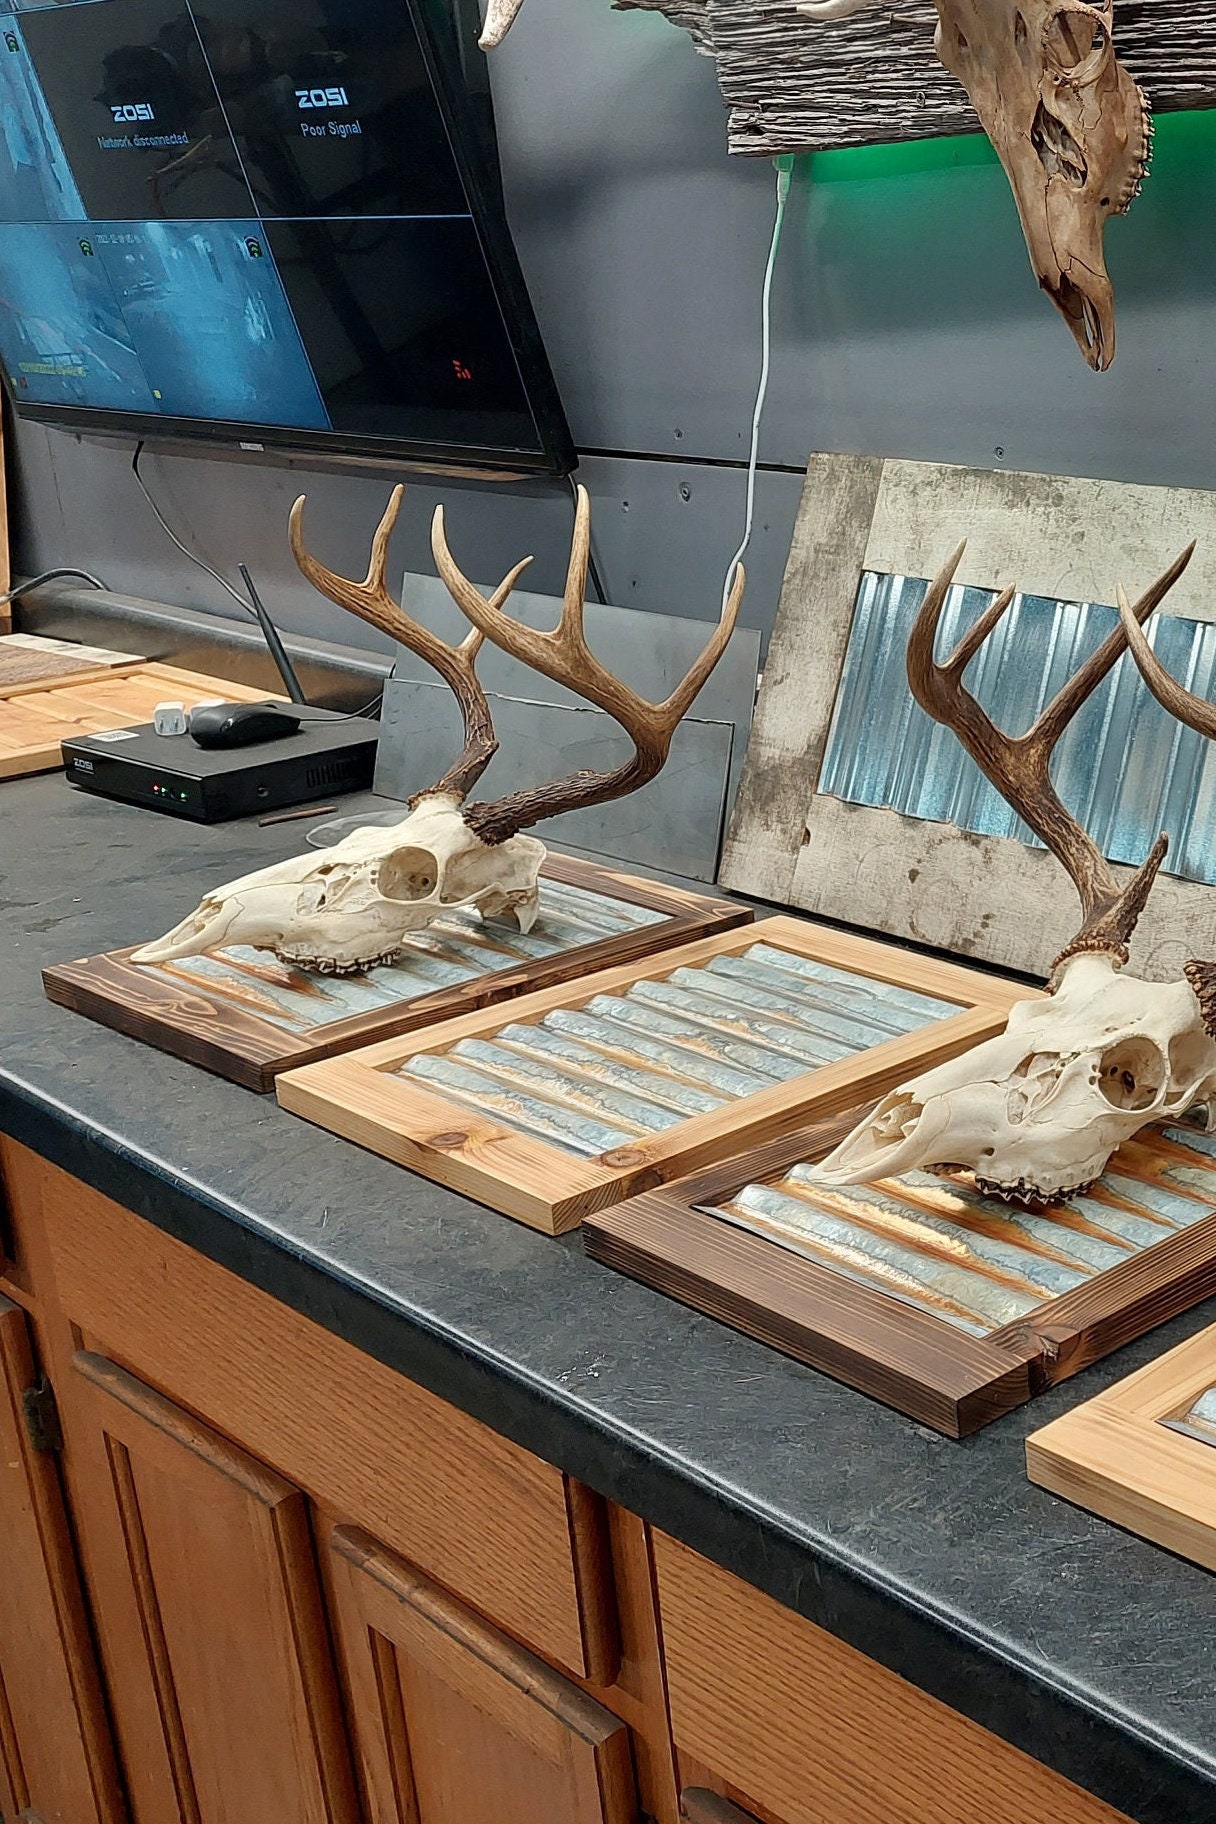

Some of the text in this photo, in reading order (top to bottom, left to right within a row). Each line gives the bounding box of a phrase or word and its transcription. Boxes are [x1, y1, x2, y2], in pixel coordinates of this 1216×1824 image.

[294, 87, 349, 109] ZOSI
[110, 103, 155, 122] ZOSI
[300, 120, 362, 138] Poor Signal
[133, 131, 189, 147] disconnected
[73, 757, 94, 771] ZOSI
